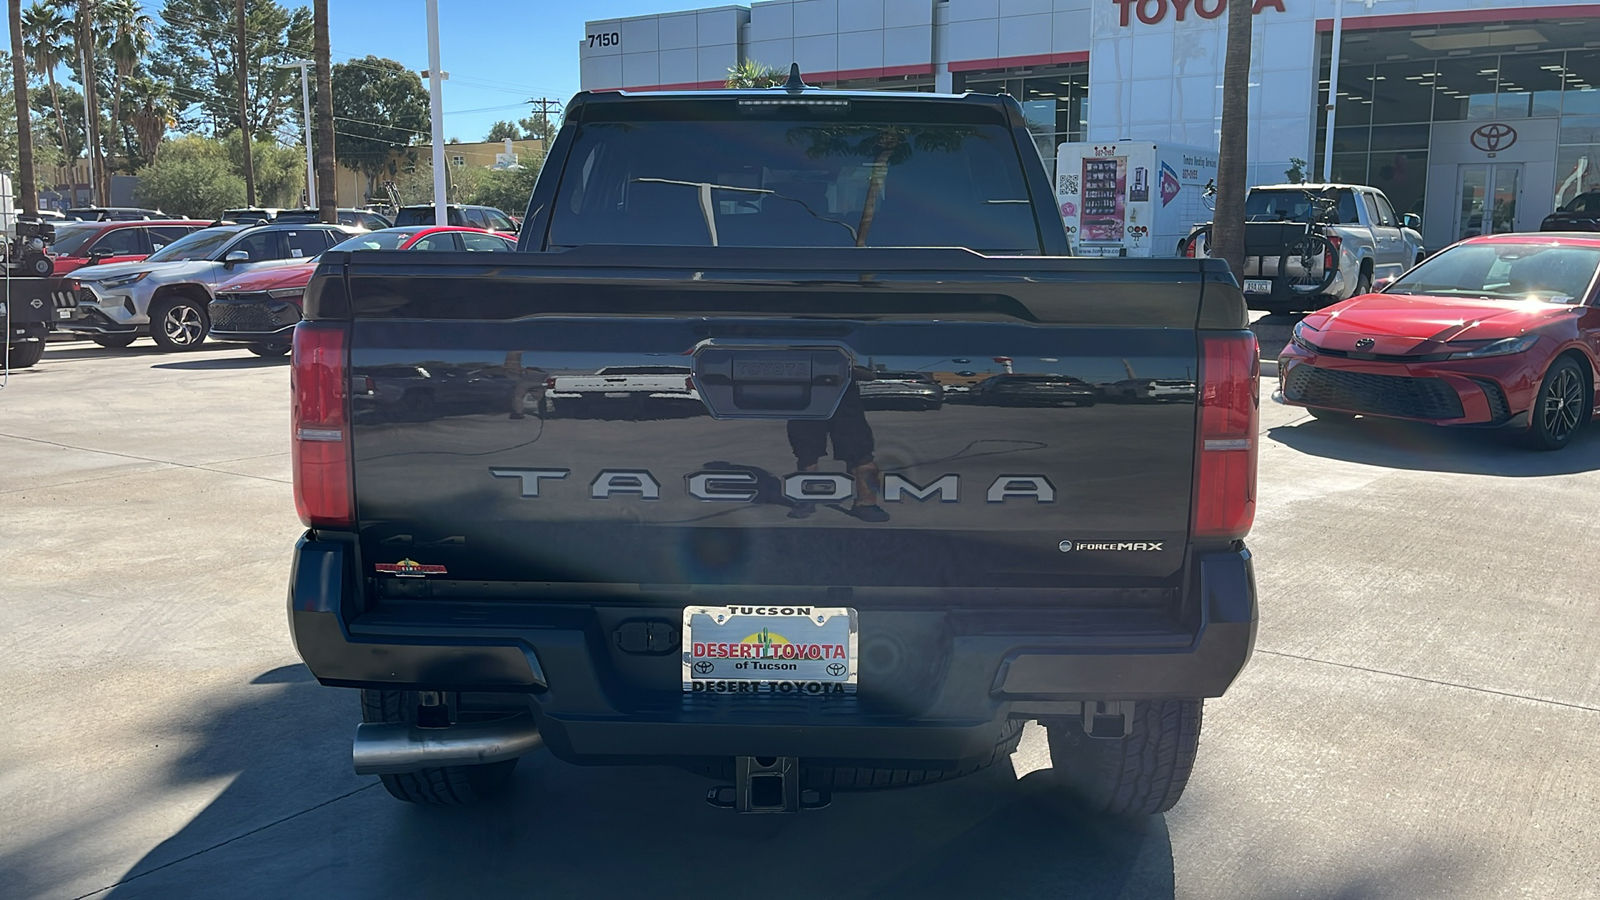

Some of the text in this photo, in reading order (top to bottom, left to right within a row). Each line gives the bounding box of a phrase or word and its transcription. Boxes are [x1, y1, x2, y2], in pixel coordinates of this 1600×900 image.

[1112, 0, 1286, 27] TOYOA
[588, 32, 619, 48] 7150
[737, 362, 809, 377] TOYOTA
[488, 466, 1058, 504] TACOMA
[728, 606, 811, 616] TUCSON
[693, 643, 846, 660] DESERT TOYOTA
[735, 661, 797, 671] of Tucson
[692, 681, 845, 694] DESERT TOYOTA
